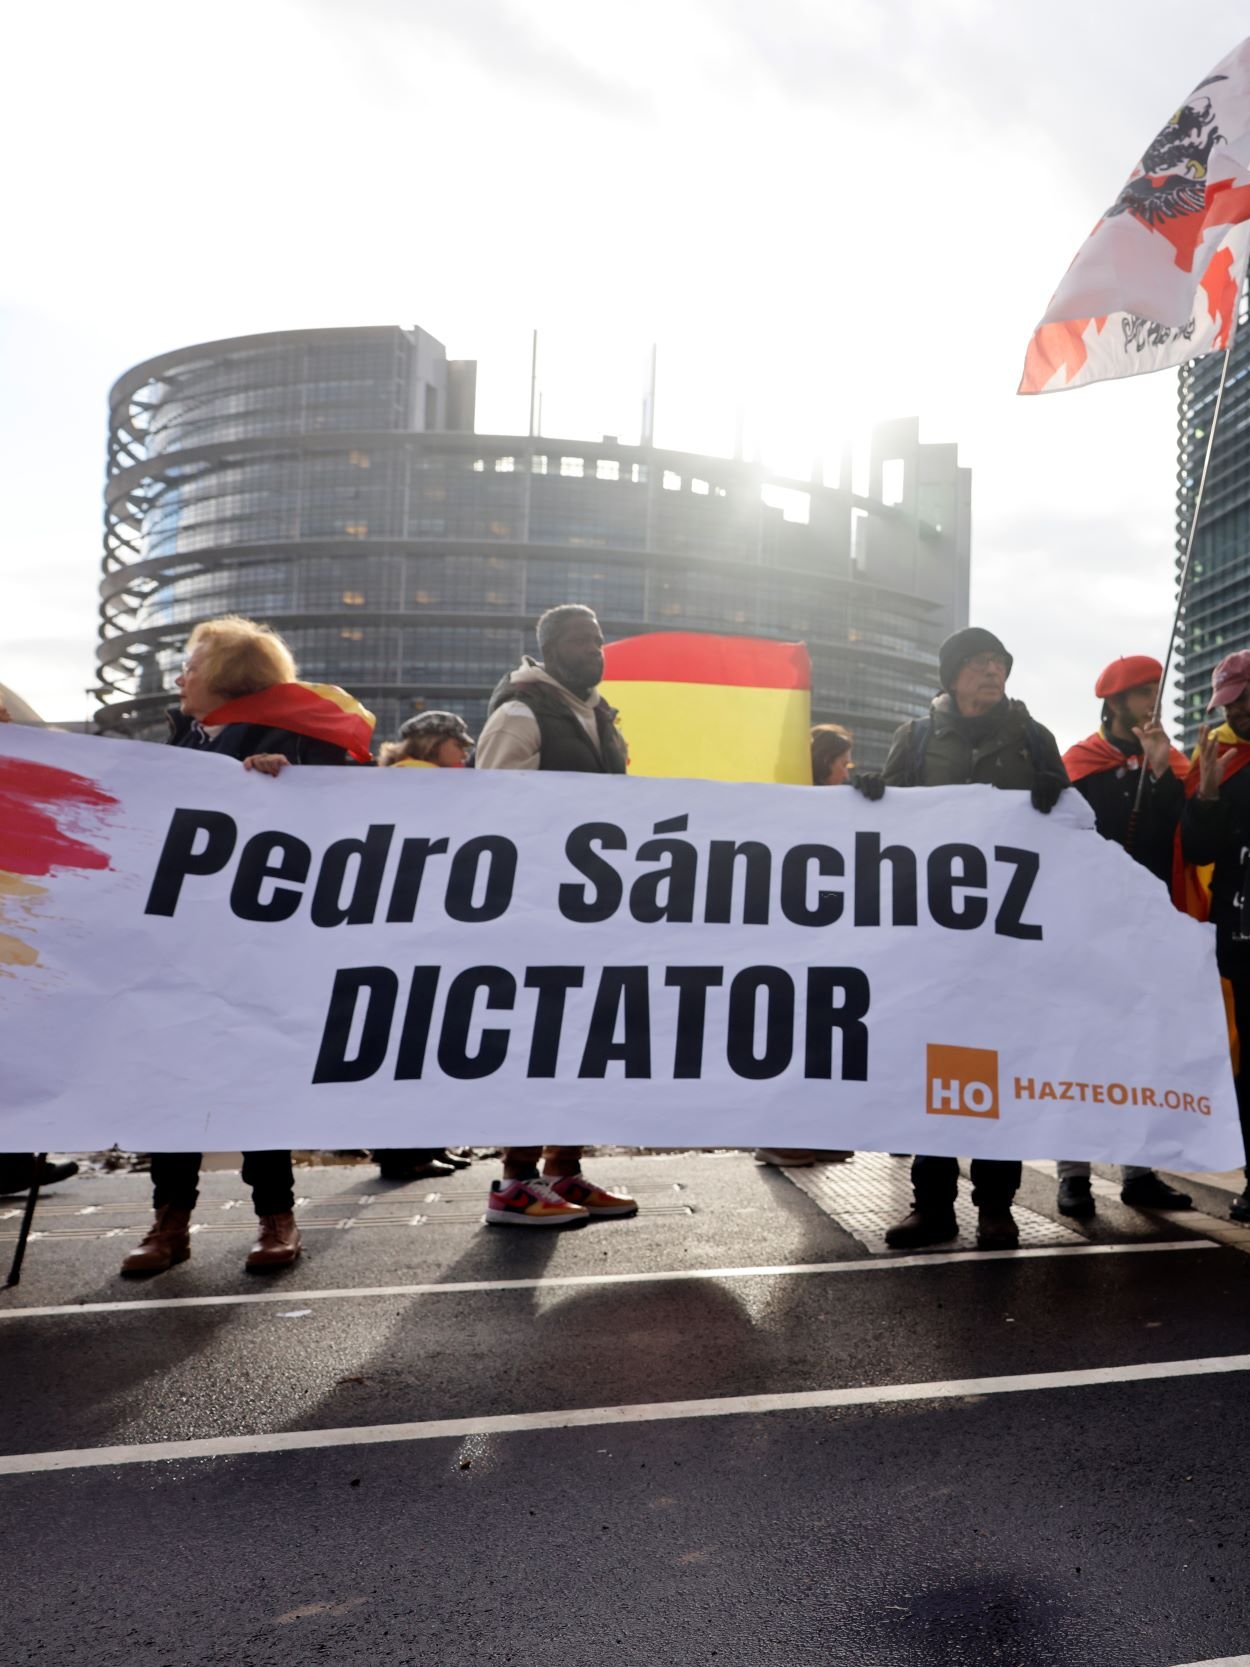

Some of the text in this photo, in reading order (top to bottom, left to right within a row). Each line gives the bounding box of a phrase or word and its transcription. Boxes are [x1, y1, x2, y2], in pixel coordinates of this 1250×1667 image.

[144, 808, 1043, 941] Pedro Sánchez
[311, 965, 871, 1085] DICTATOR
[932, 1078, 993, 1112] HO
